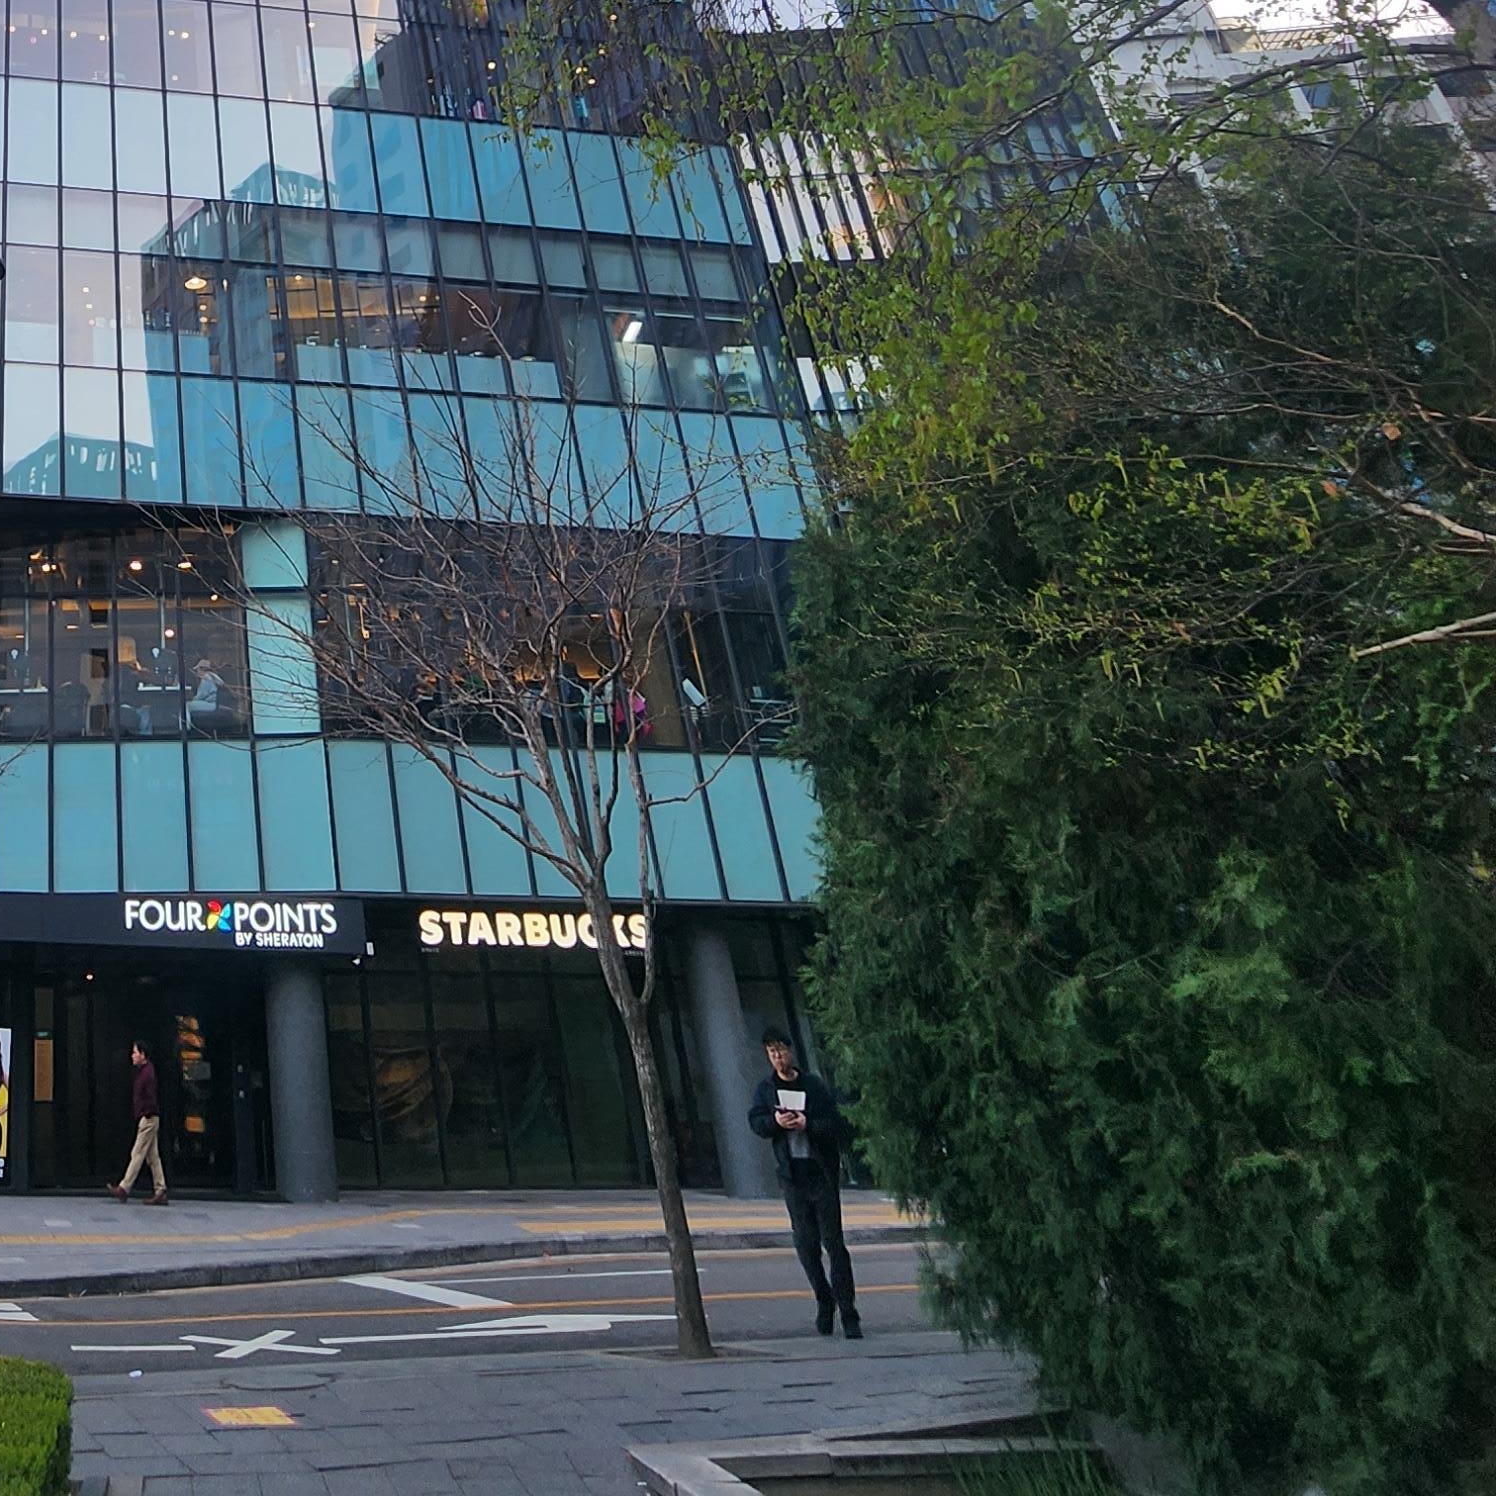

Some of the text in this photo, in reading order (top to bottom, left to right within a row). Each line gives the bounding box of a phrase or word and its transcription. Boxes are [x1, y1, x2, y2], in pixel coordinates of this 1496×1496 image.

[125, 899, 337, 934] FOUR POINTS
[235, 932, 324, 948] BY SHERATON
